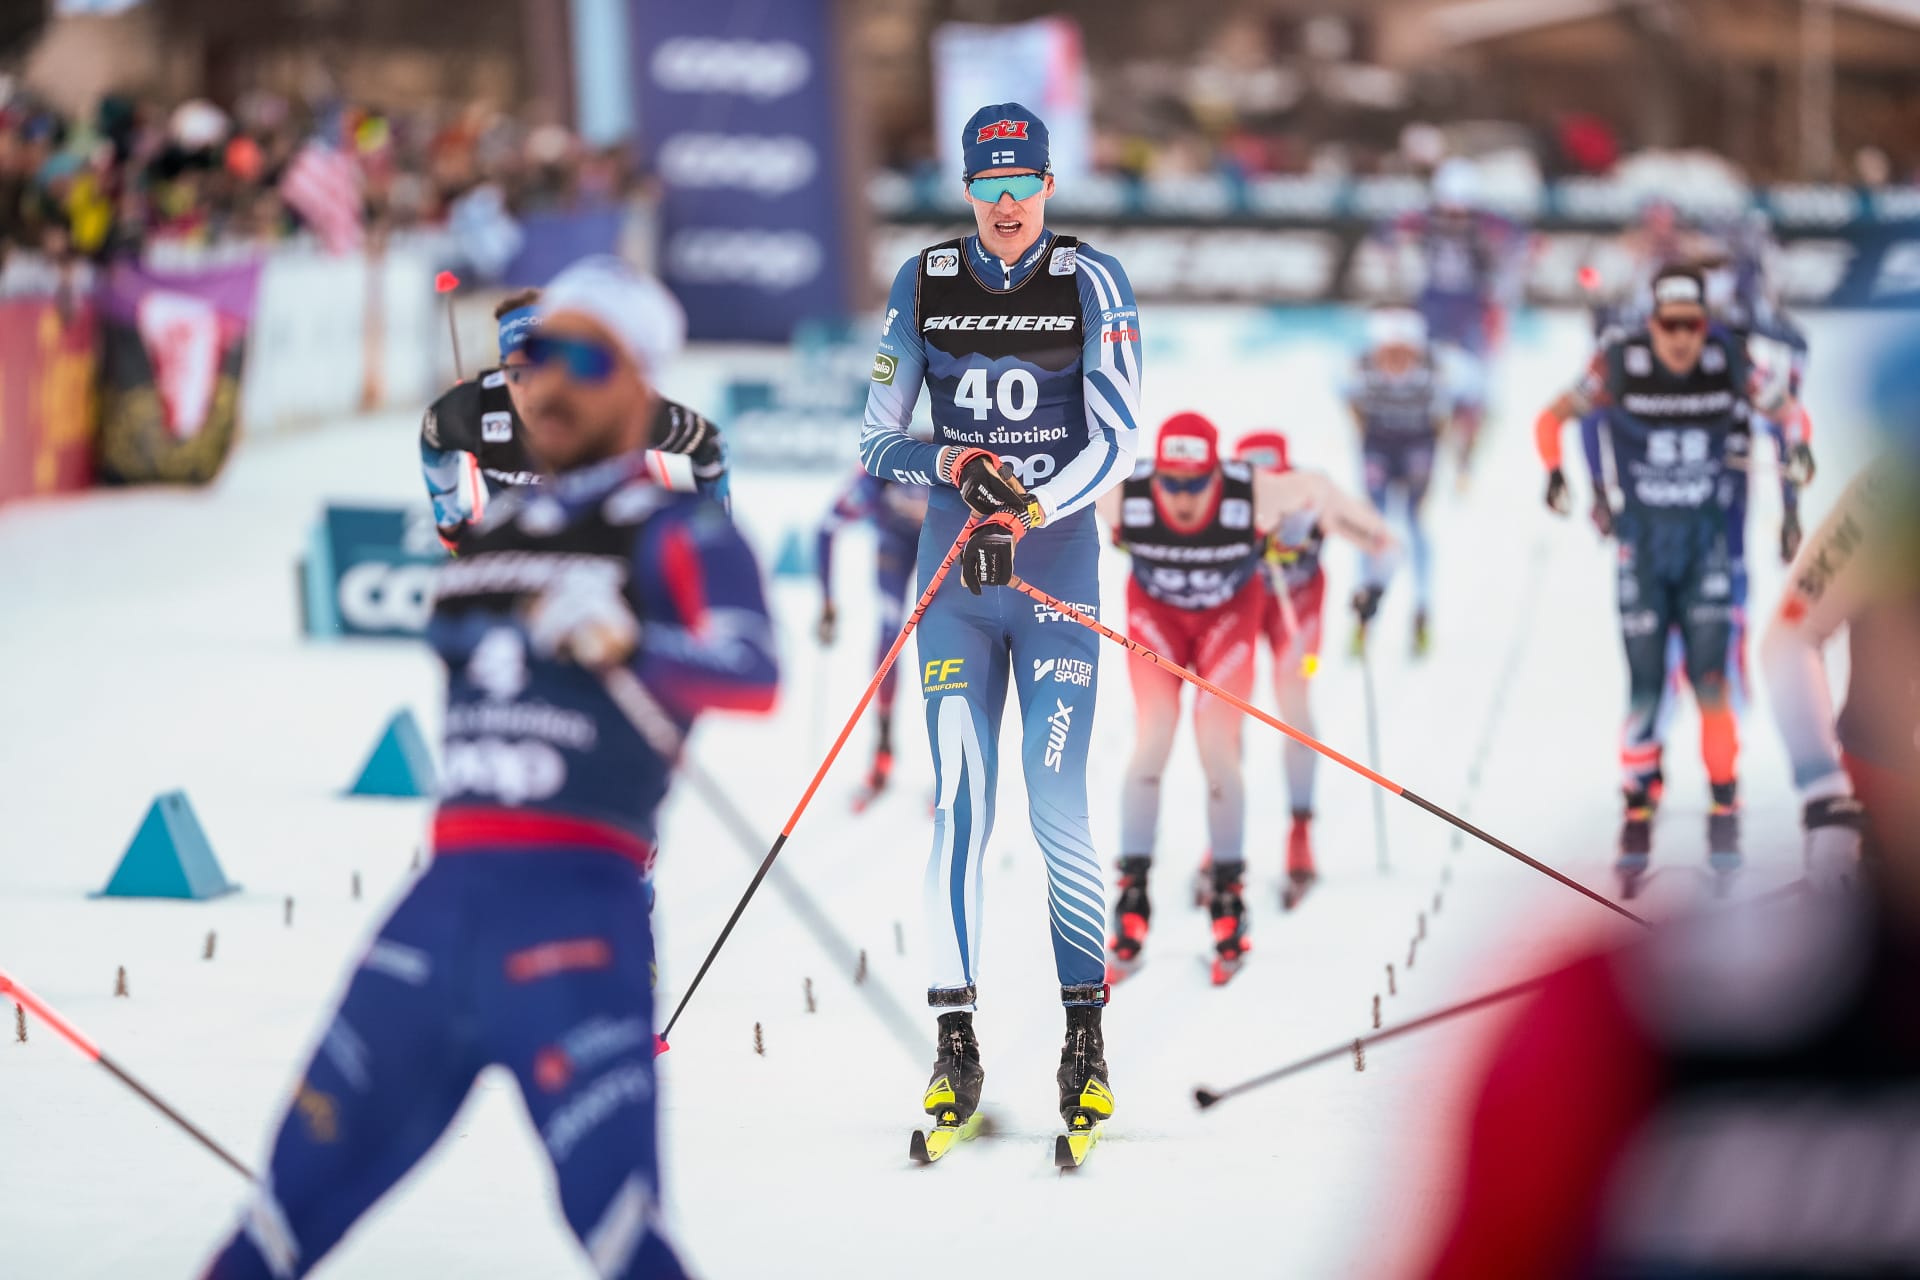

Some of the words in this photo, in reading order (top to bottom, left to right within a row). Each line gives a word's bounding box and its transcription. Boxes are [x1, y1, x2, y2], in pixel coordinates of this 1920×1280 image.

[923, 315, 1077, 332] SKECHERS
[954, 368, 1039, 421] 40
[942, 425, 984, 443] Toblach
[892, 468, 936, 486] FIN
[1035, 611, 1095, 624] TYR
[924, 658, 965, 684] FF
[1056, 658, 1092, 676] INTER
[1054, 670, 1092, 688] SPORT
